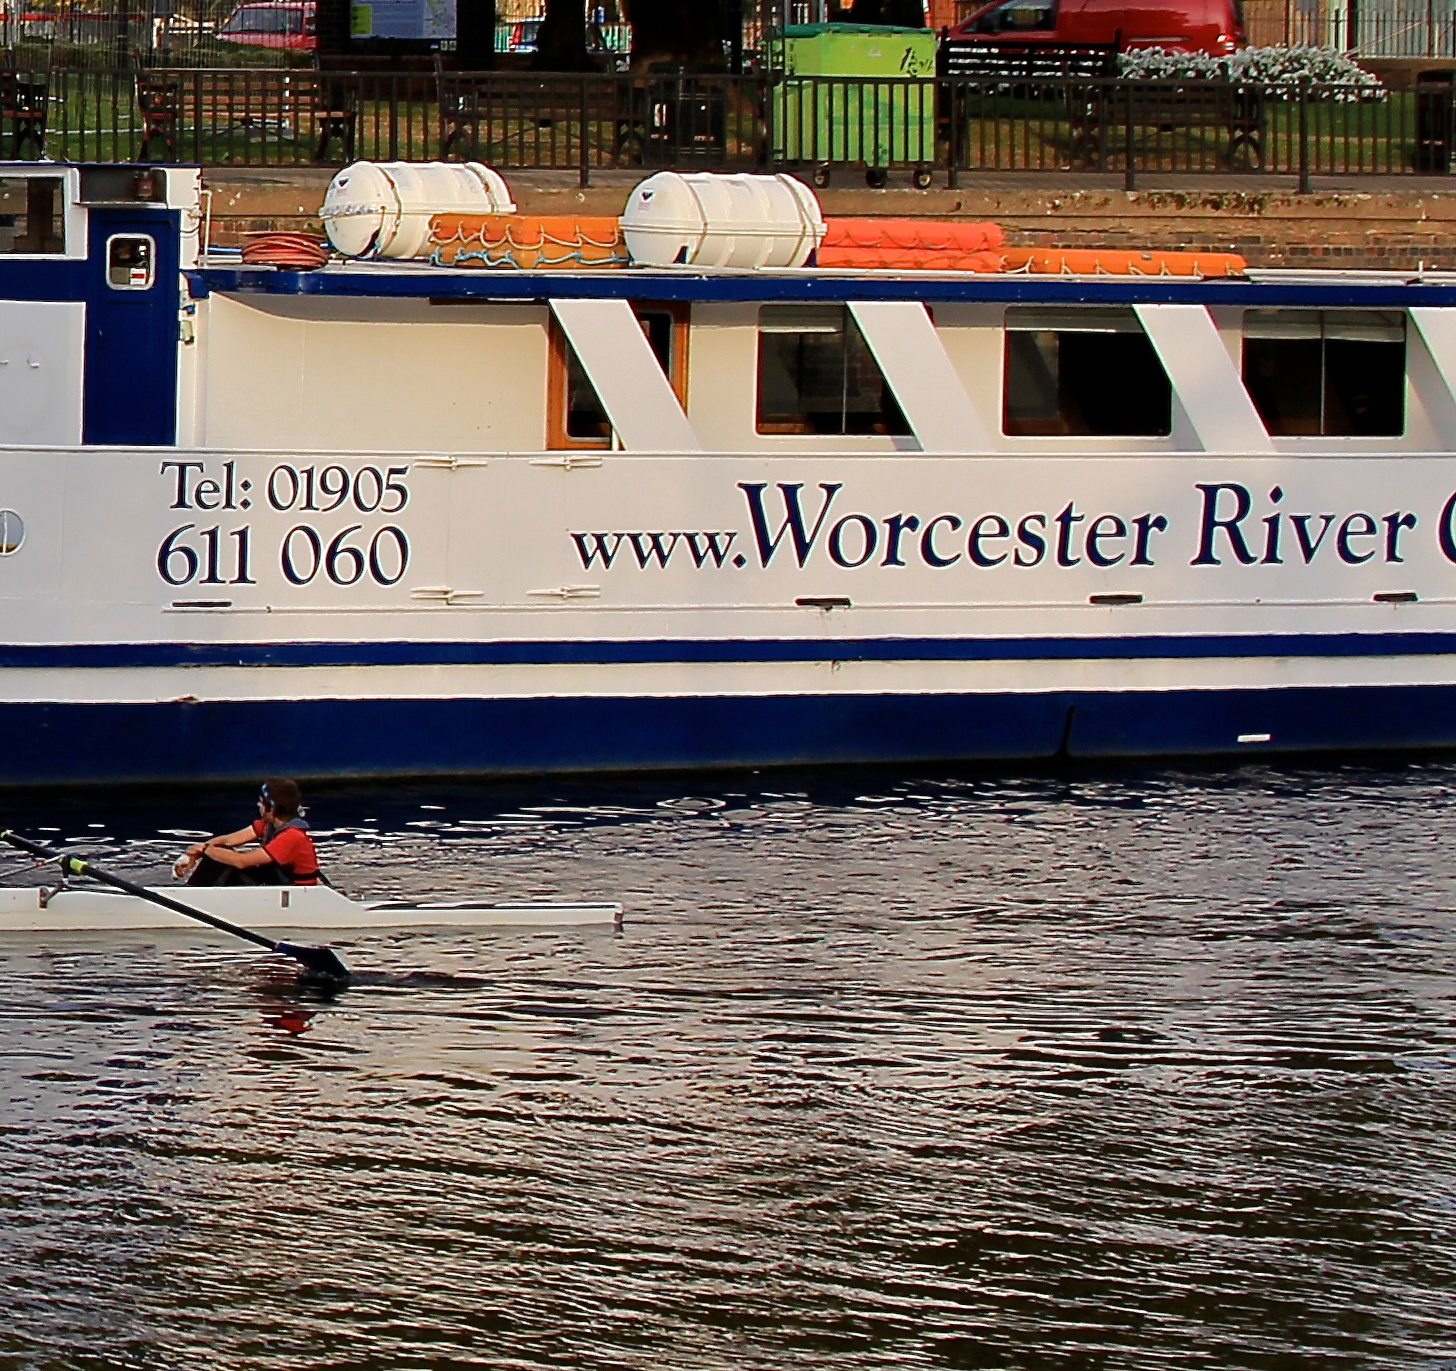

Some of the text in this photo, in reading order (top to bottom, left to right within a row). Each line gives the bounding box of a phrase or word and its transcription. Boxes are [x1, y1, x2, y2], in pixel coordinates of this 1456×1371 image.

[159, 459, 410, 513] Tel: 01905
[156, 523, 411, 586] 611 060
[1189, 482, 1417, 566] River
